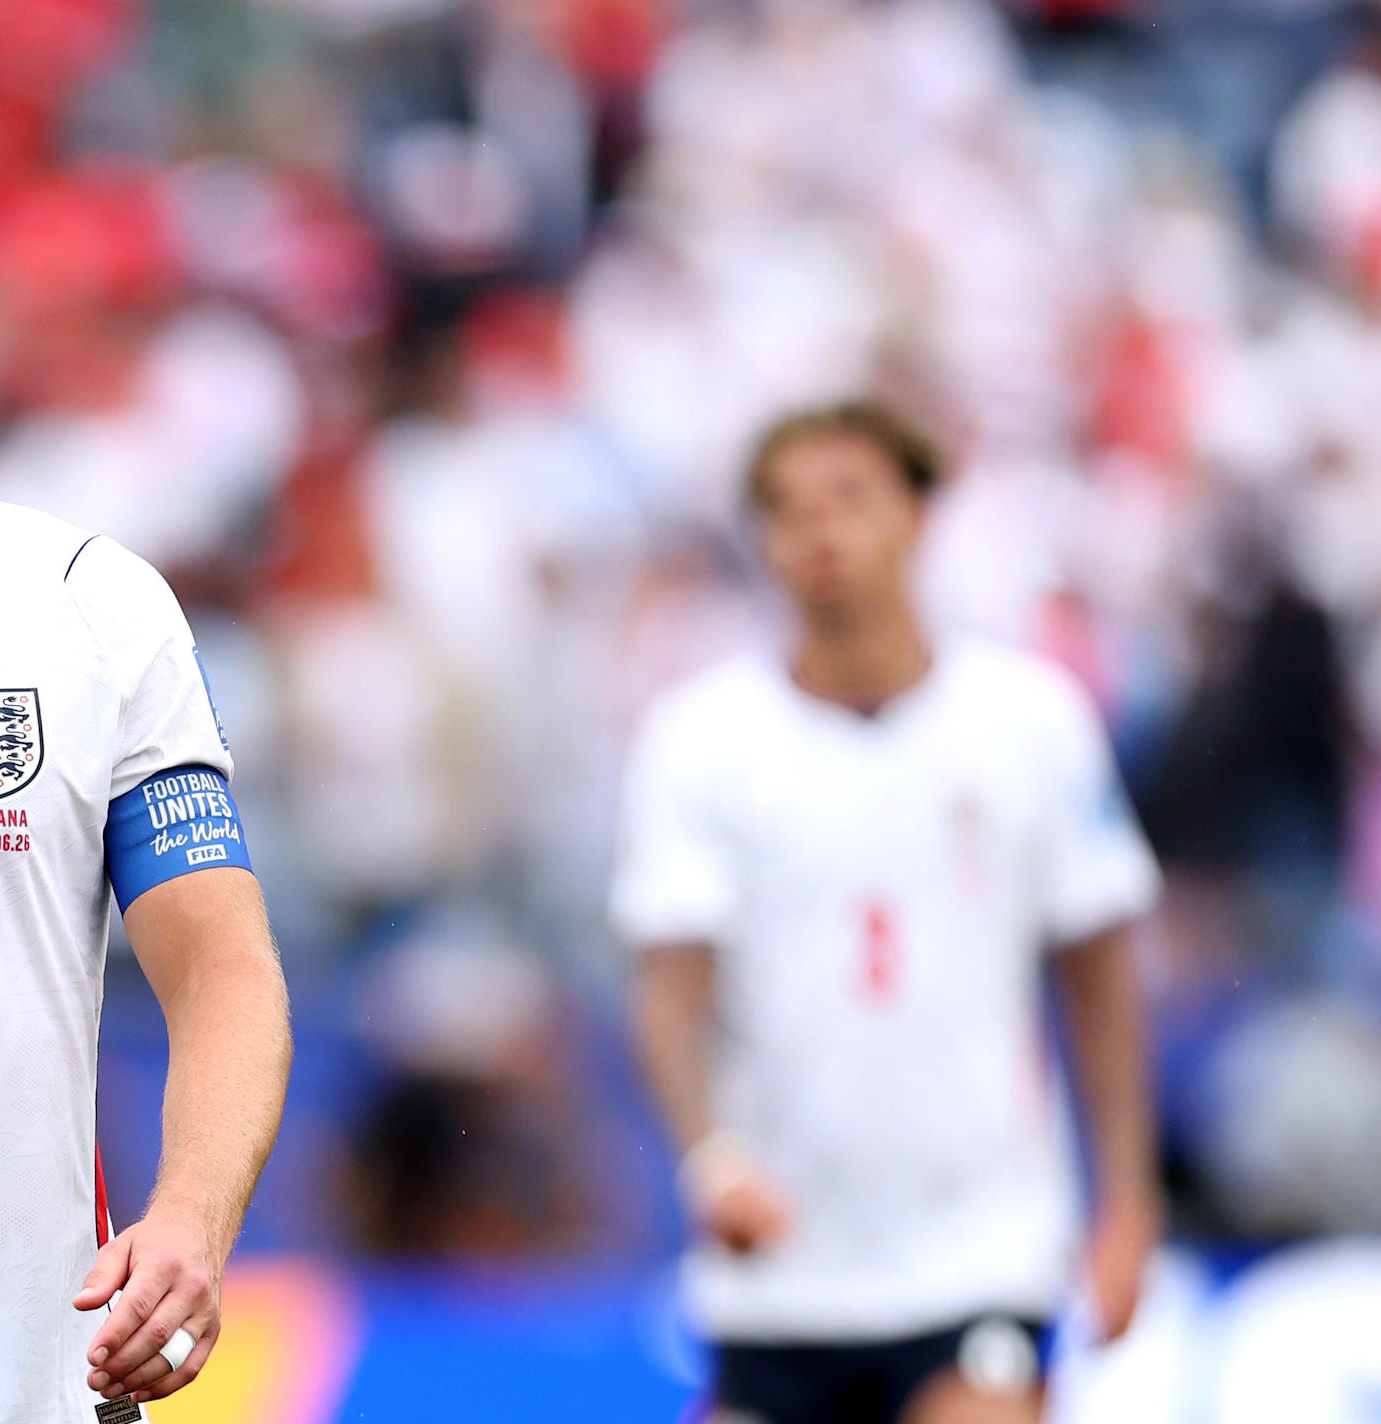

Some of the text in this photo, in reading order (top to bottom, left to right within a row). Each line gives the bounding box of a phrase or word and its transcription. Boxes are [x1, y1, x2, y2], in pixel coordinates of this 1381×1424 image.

[142, 773, 225, 804] FOOTBALL
[148, 792, 233, 830] UNITES
[149, 818, 241, 856] the World
[190, 847, 224, 861] FIFA
